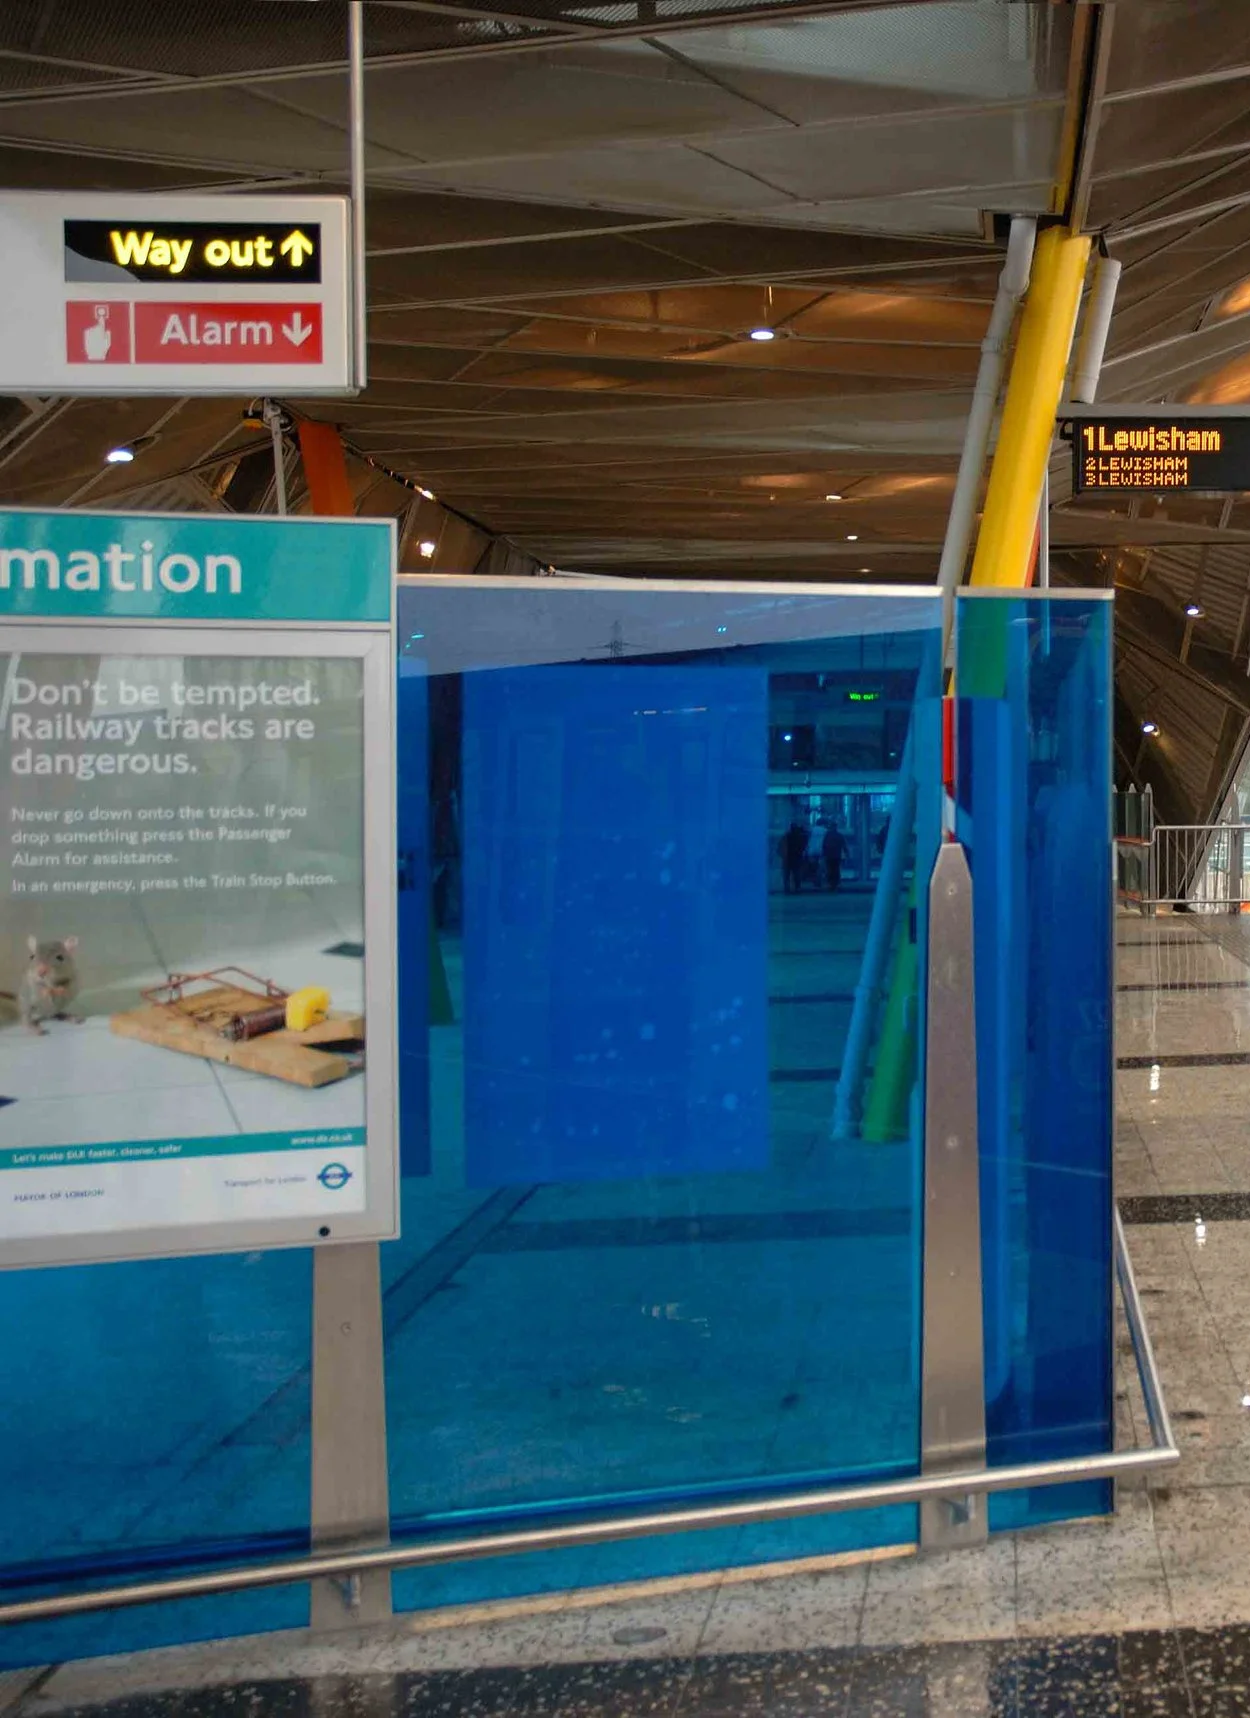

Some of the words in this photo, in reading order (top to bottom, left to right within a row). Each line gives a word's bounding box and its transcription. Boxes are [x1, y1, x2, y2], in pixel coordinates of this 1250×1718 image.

[110, 230, 193, 273] Way
[204, 236, 274, 267] out
[160, 313, 273, 346] Alarm
[1098, 426, 1220, 451] Lewisham
[1085, 459, 1096, 471] 2
[1099, 457, 1188, 471] LEWISHAM
[1085, 473, 1096, 486] 3
[1099, 472, 1188, 486] LEWISHAM
[11, 677, 109, 706] Don't
[118, 679, 160, 706] be
[170, 679, 320, 712] tempted.
[11, 712, 143, 746] Railway
[153, 713, 255, 740] tracks
[264, 718, 315, 740] are
[11, 747, 198, 780] dangerous.
[11, 807, 60, 822] Never
[63, 809, 84, 824] go
[89, 804, 132, 821] down
[137, 806, 174, 821] onto
[179, 805, 204, 819] the
[209, 805, 260, 819] tracks.
[265, 804, 276, 817] If
[280, 806, 307, 820] you
[11, 829, 50, 846] drop
[54, 828, 138, 845] something
[142, 829, 184, 845] press
[188, 828, 214, 841] the
[218, 825, 292, 843] Passenger
[11, 851, 60, 867] Alarm
[64, 850, 88, 865] for
[93, 850, 179, 865] assistance.
[12, 879, 26, 893] In
[30, 880, 49, 892] an
[140, 877, 179, 893] press
[183, 875, 207, 888] the
[211, 873, 246, 888] Train
[250, 872, 283, 889] Stop
[286, 871, 338, 887] Button.
